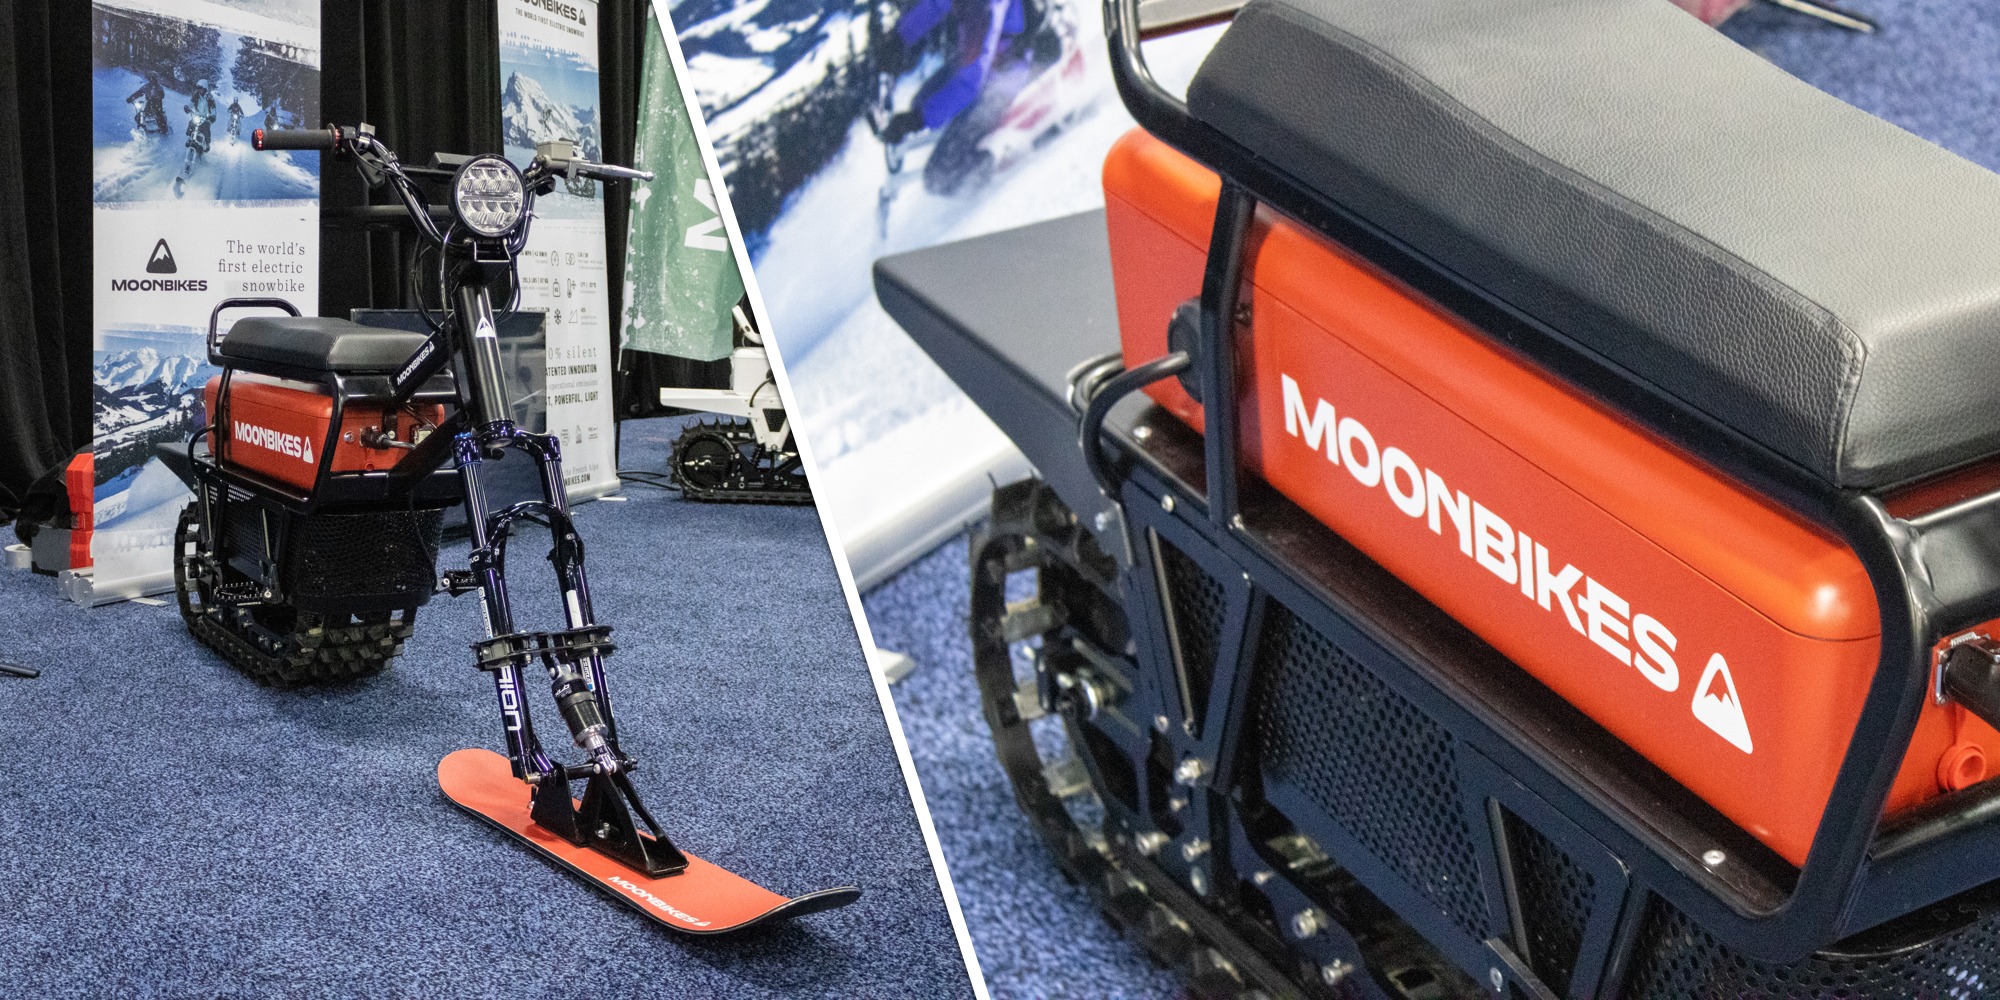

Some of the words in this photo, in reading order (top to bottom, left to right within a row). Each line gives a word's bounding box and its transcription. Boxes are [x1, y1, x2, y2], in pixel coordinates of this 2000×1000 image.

[518, 0, 578, 21] ONBIKES
[524, 11, 537, 22] WORLD
[537, 15, 549, 26] FIRST
[549, 20, 566, 32] ELECTRIC
[226, 240, 253, 254] The
[257, 241, 305, 255] world's
[218, 259, 247, 273] first
[251, 260, 303, 274] electric
[111, 279, 208, 292] MOONBIKES
[242, 279, 305, 292] snowbike
[566, 345, 597, 359] silent
[396, 346, 430, 386] MOONBIKES
[546, 365, 567, 377] ATENTED
[568, 363, 597, 375] INNOVATION
[554, 393, 583, 406] POWERFUL,
[584, 391, 599, 402] LIGHT
[234, 420, 302, 458] MOONBIKES
[563, 473, 591, 487] NBIKES.COM
[1281, 373, 1680, 693] MOONBIKES
[607, 876, 700, 923] MOONBIKES
